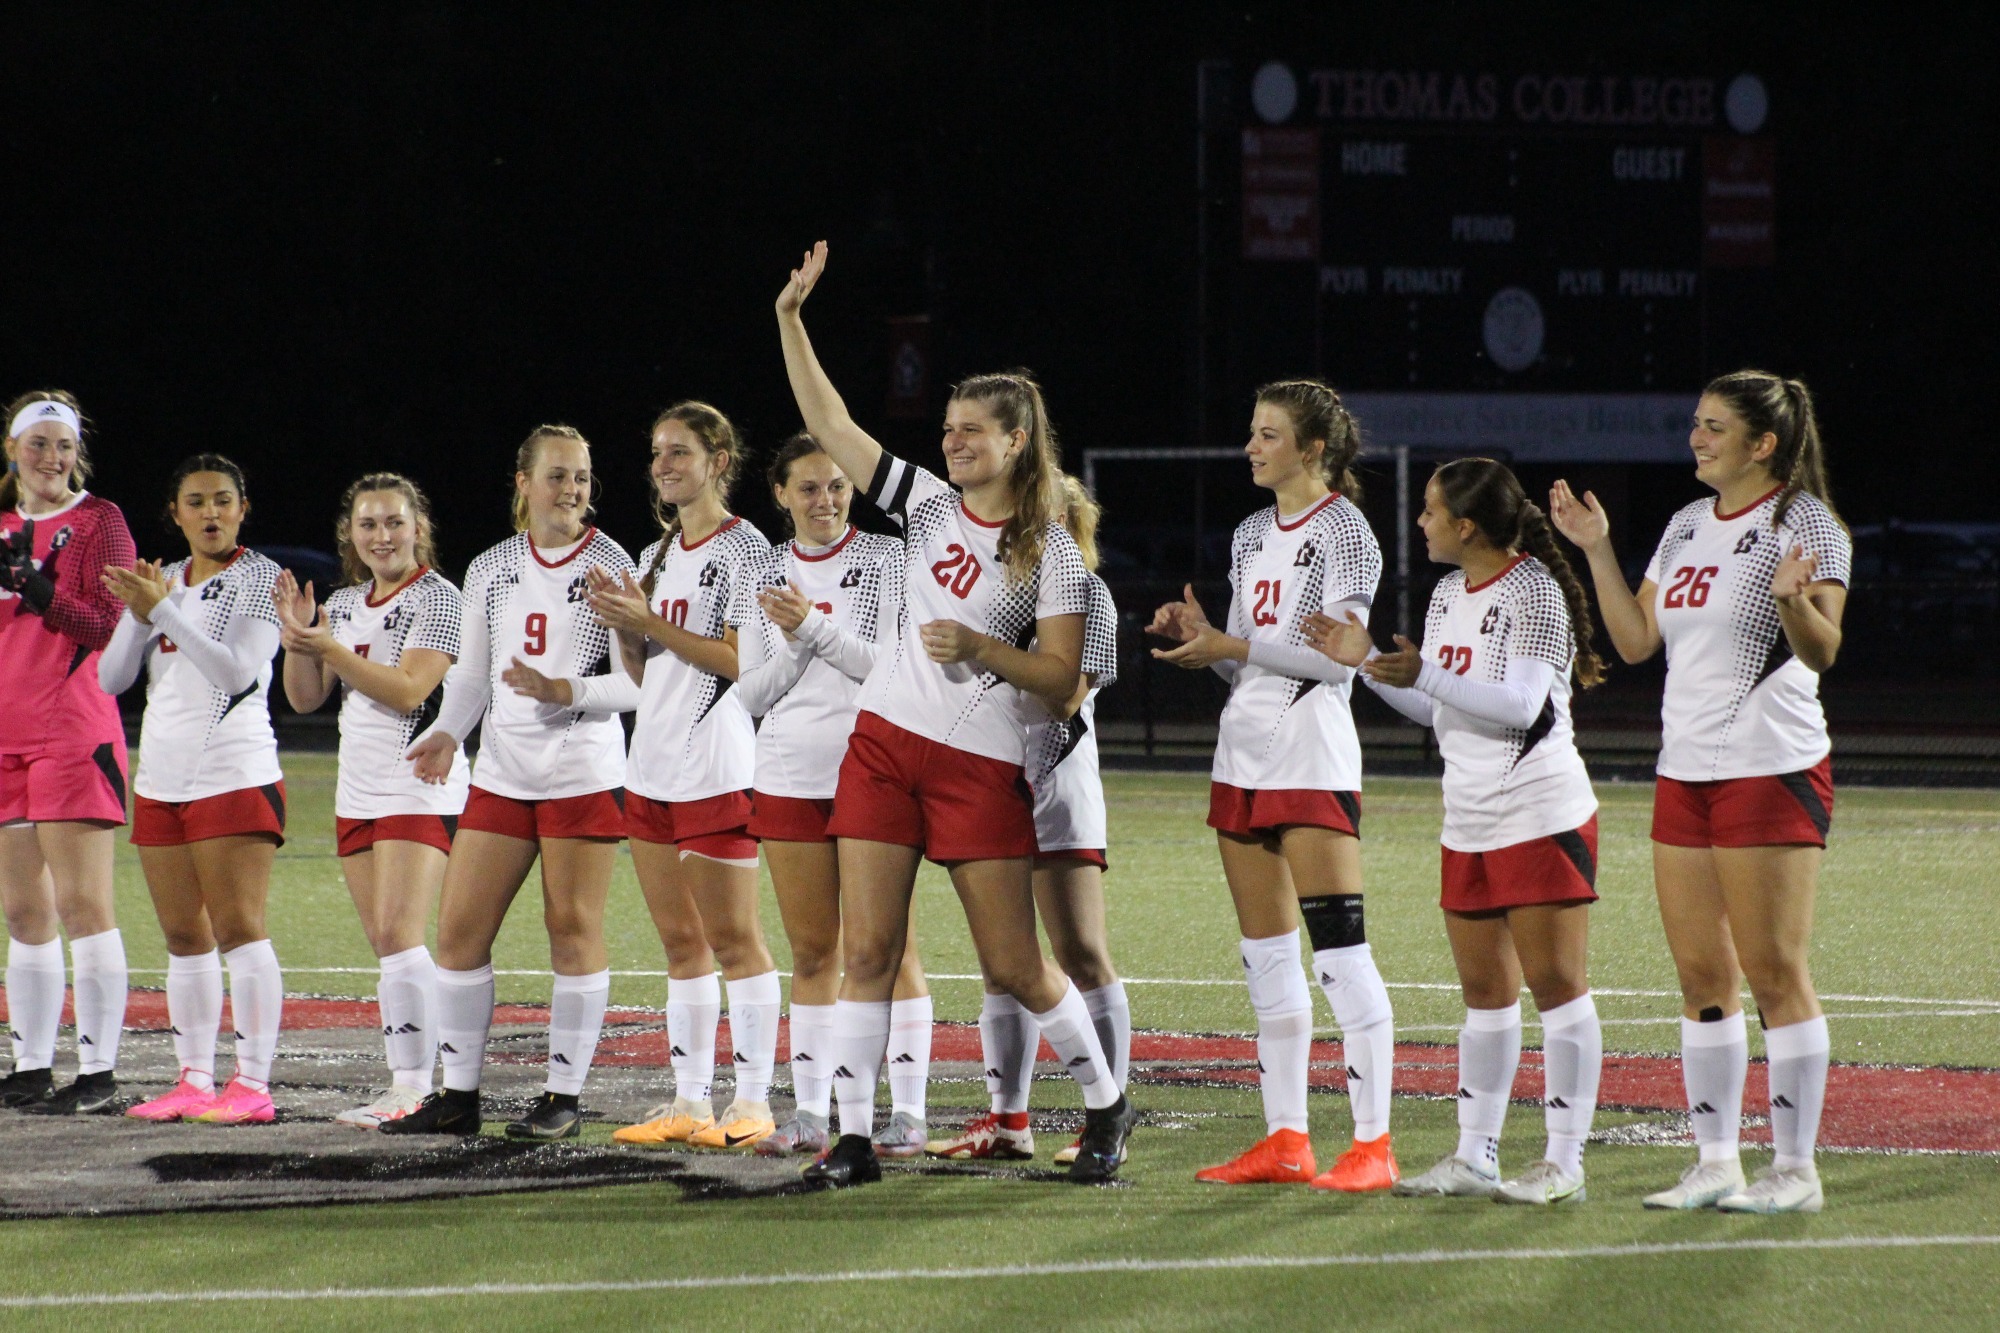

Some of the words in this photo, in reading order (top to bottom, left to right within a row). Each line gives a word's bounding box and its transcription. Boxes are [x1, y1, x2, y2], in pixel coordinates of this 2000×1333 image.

[1309, 69, 1498, 121] THOMAS
[1511, 74, 1717, 125] COLLEGE
[1341, 141, 1407, 175] HOME
[1612, 146, 1686, 181] GUEST
[1450, 214, 1515, 242] PERIOD
[1319, 265, 1368, 294] PLYR
[1382, 265, 1463, 294] PENALTY
[1557, 268, 1604, 296] PLYR
[1618, 268, 1698, 297] PENALTY
[1586, 404, 1658, 434] Bank
[931, 543, 983, 600] 20
[1663, 565, 1719, 609] 26
[660, 599, 689, 629] 10
[1252, 579, 1281, 627] 21
[523, 612, 547, 656] 9
